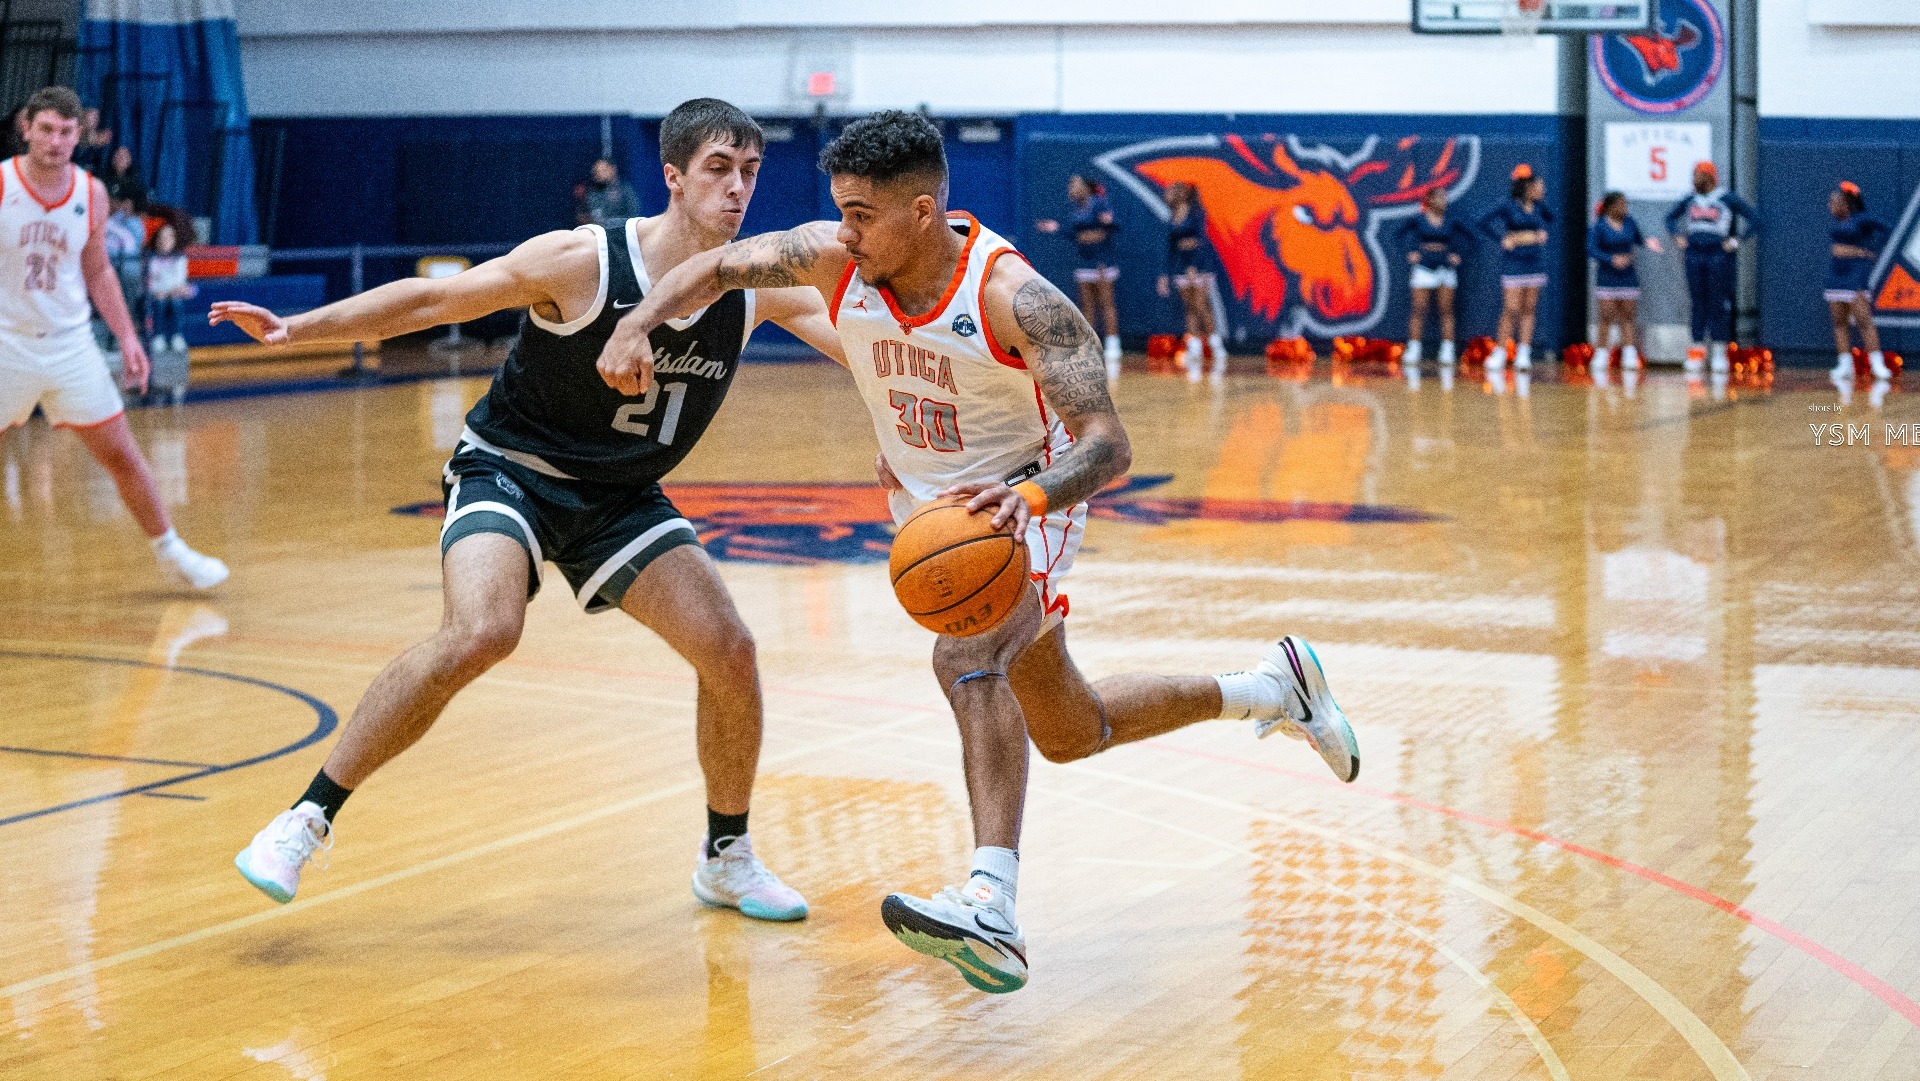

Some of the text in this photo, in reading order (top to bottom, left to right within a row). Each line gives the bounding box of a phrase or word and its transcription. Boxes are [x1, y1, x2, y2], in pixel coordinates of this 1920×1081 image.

[1649, 146, 1668, 181] 5
[20, 221, 69, 253] UTICA
[652, 340, 728, 380] tsdam
[872, 339, 959, 395] UTICA
[611, 379, 688, 446] 21
[1061, 386, 1086, 402] YOU
[888, 388, 965, 453] 30
